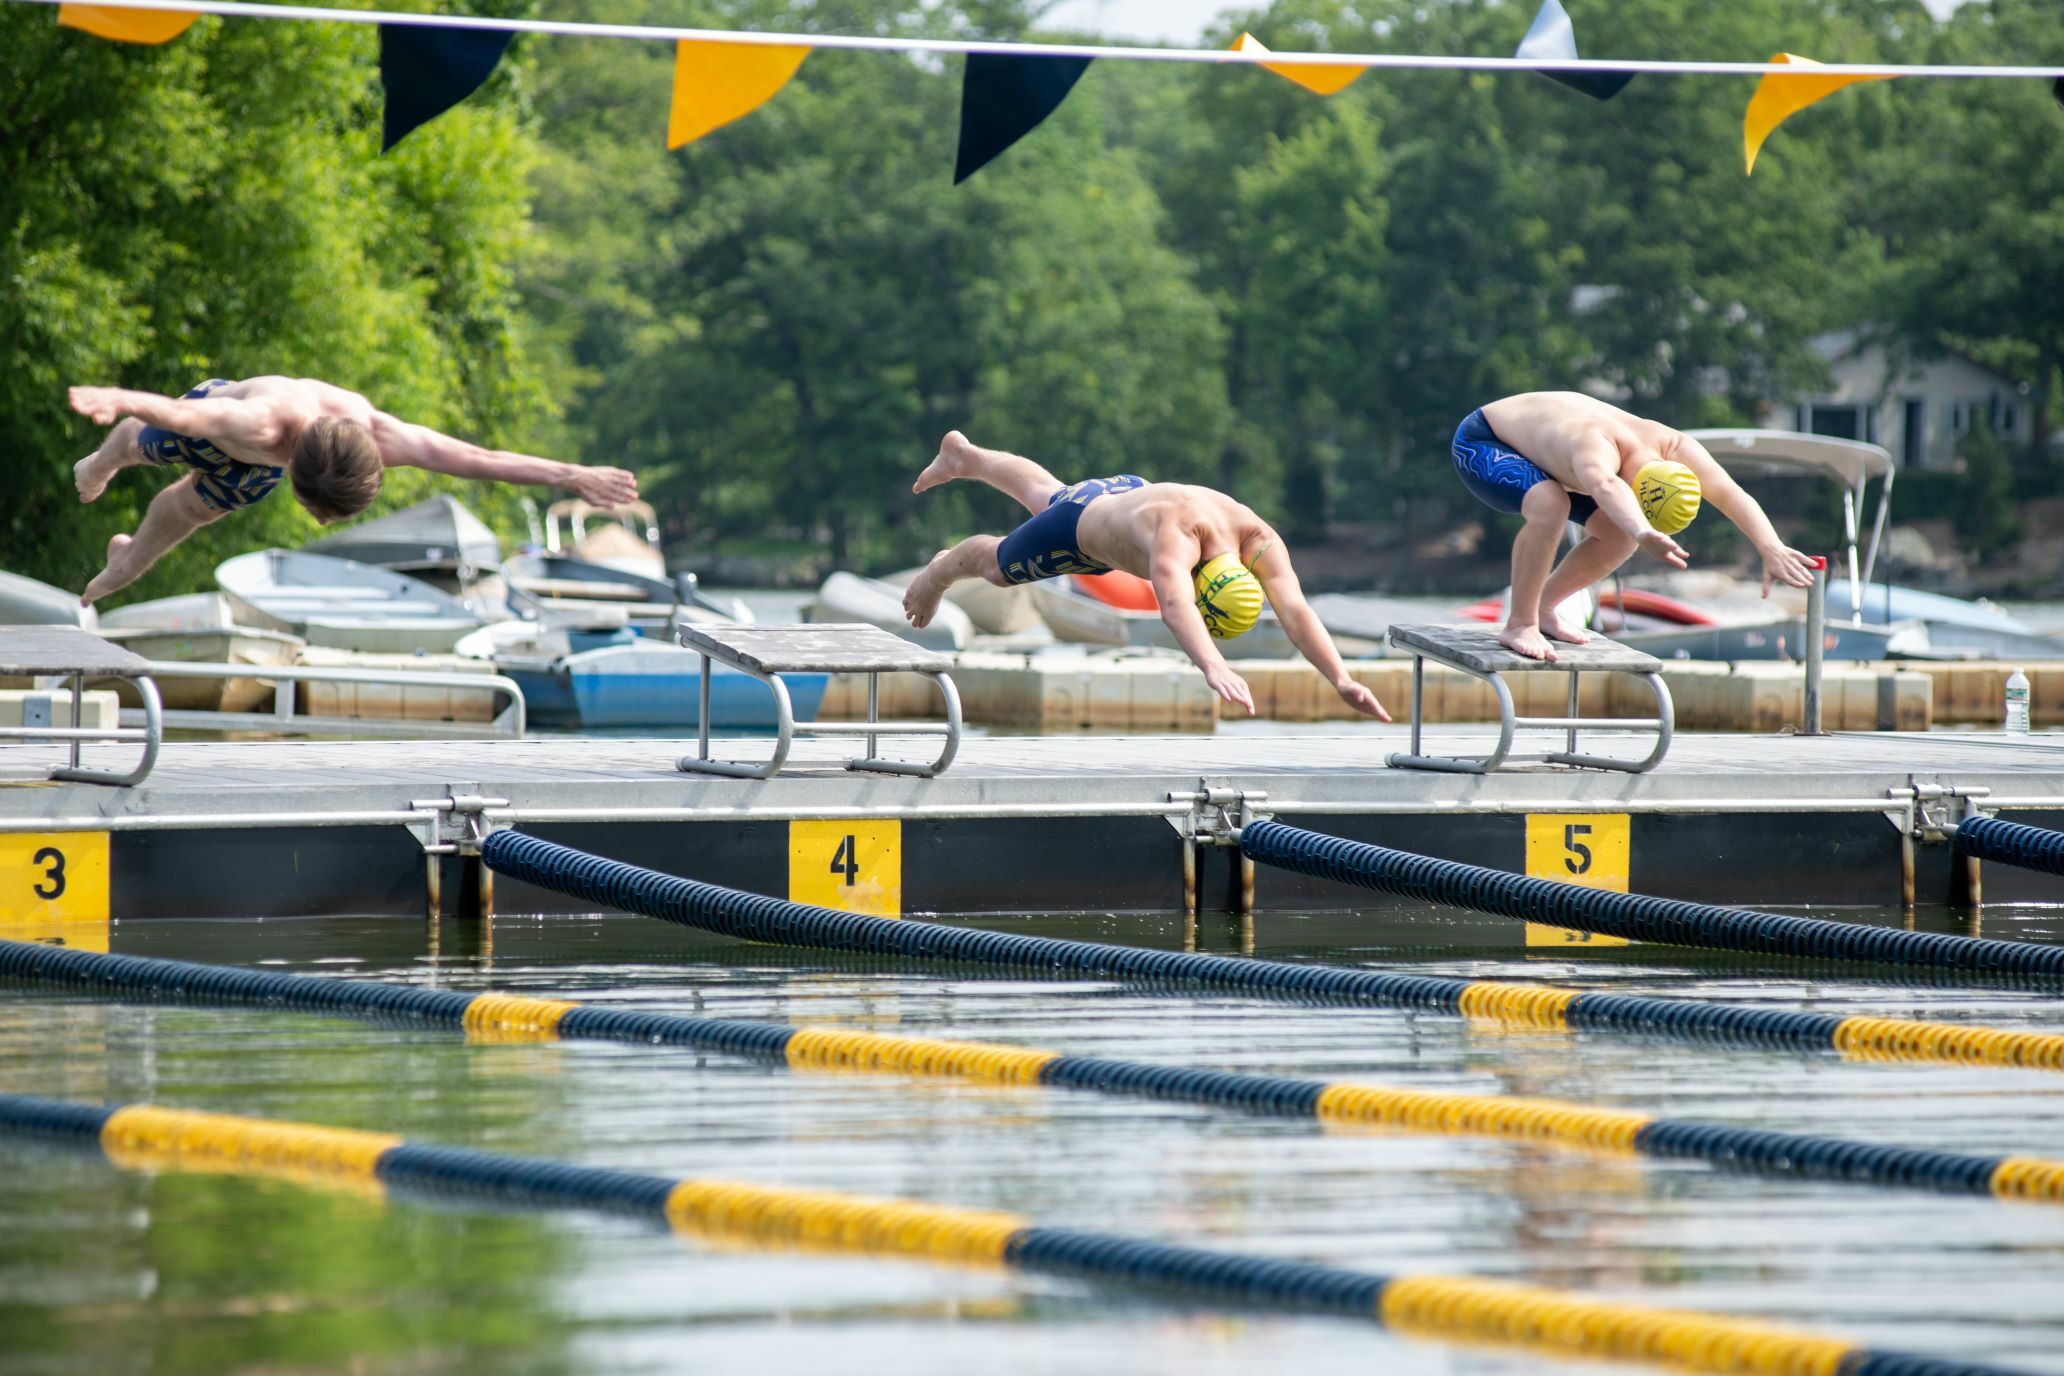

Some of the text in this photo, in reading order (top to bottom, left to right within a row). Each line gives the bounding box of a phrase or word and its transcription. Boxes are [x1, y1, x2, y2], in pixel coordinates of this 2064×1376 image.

[1640, 481, 1655, 520] HLCC
[33, 847, 66, 900] 3
[830, 835, 859, 887] 4
[1564, 824, 1592, 874] 5
